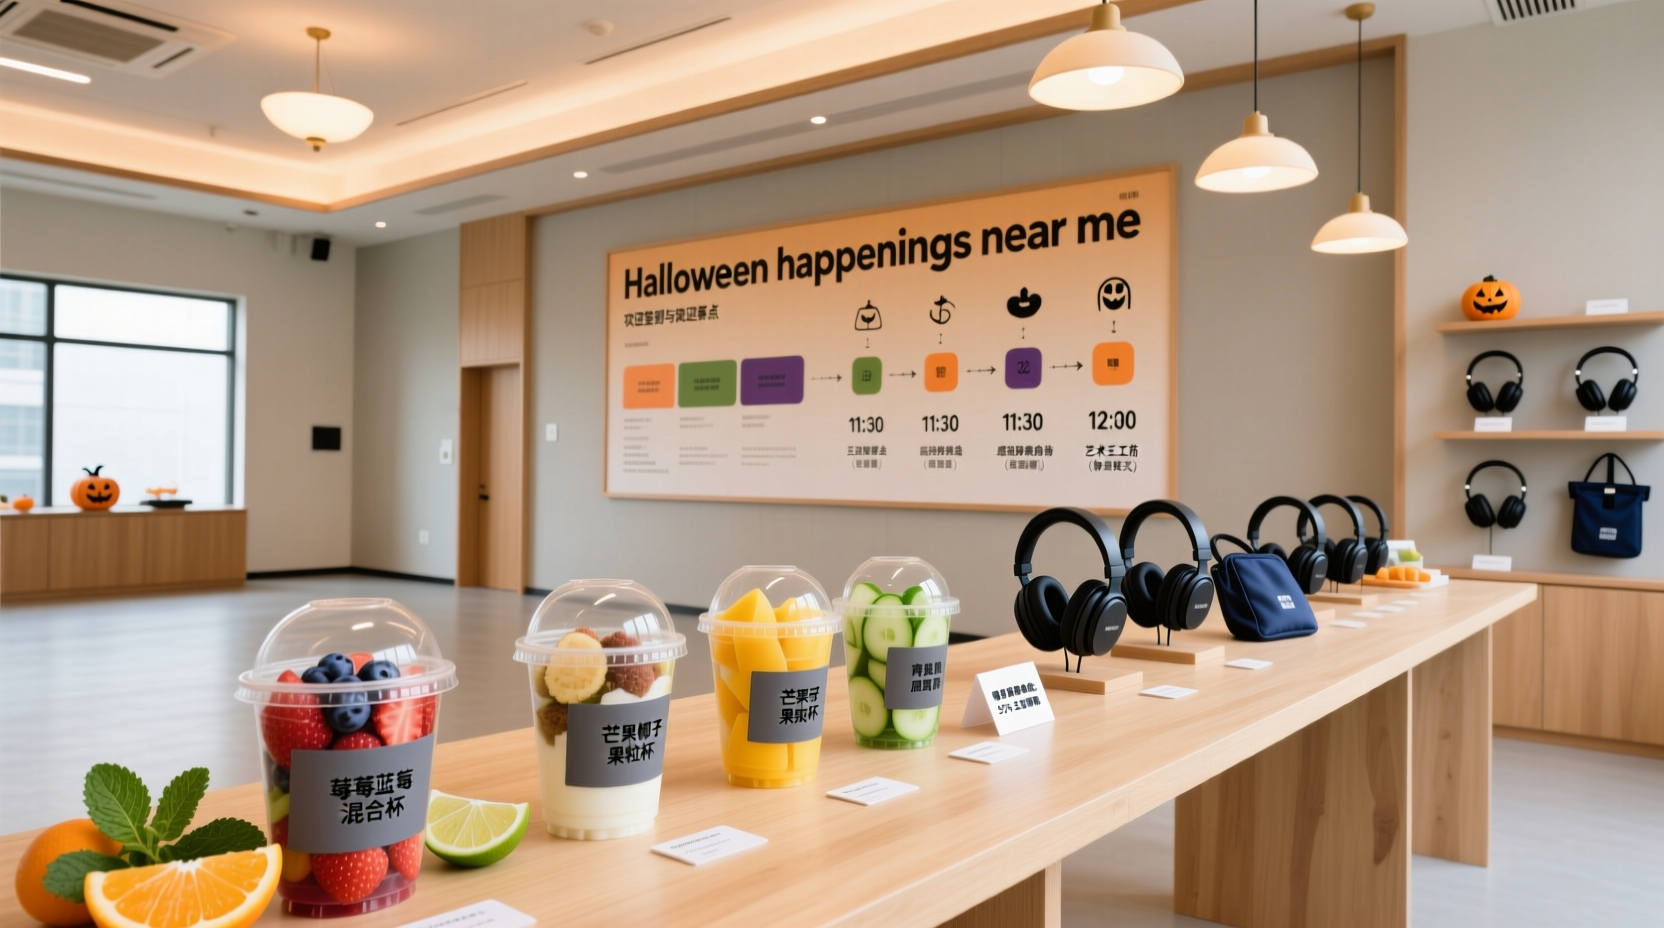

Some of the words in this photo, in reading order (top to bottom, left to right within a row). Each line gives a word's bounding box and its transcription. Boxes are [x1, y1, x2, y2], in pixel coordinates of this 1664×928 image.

[624, 256, 768, 299] Halloween
[777, 227, 971, 286] happenings
[982, 217, 1066, 256] near
[1078, 208, 1141, 244] me
[849, 416, 884, 433] 11:30
[922, 415, 960, 433] 11:30
[1002, 412, 1044, 432] 11:30
[1088, 410, 1137, 431] 12:00
[339, 795, 406, 825] 混合杯
